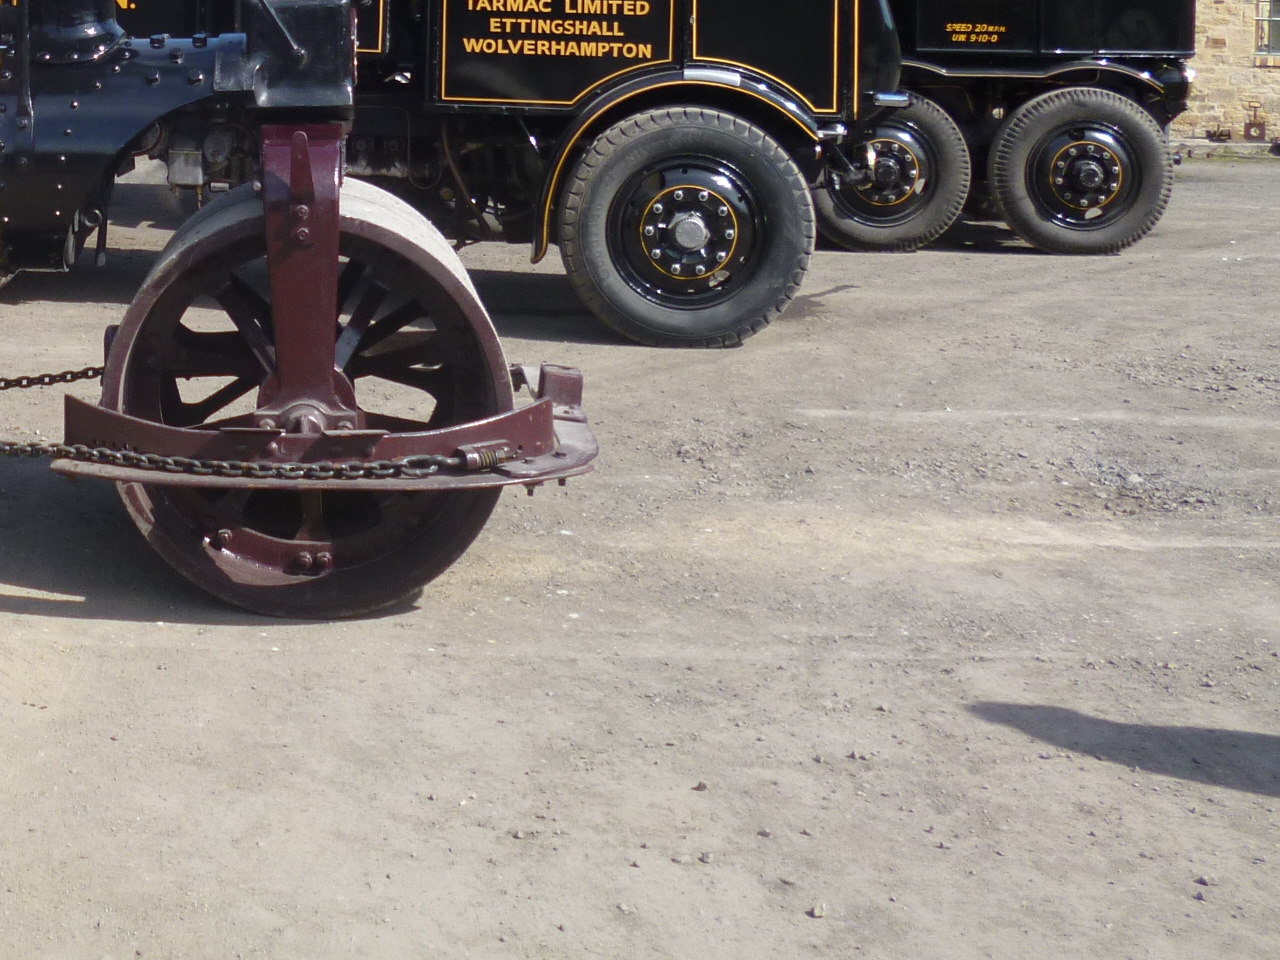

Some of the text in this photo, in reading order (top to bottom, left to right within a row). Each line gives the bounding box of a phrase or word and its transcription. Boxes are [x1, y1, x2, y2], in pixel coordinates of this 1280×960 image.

[489, 17, 625, 37] ETTINGSHALL
[945, 23, 973, 33] SPEED
[462, 37, 653, 59] WOLVERHAMPTON
